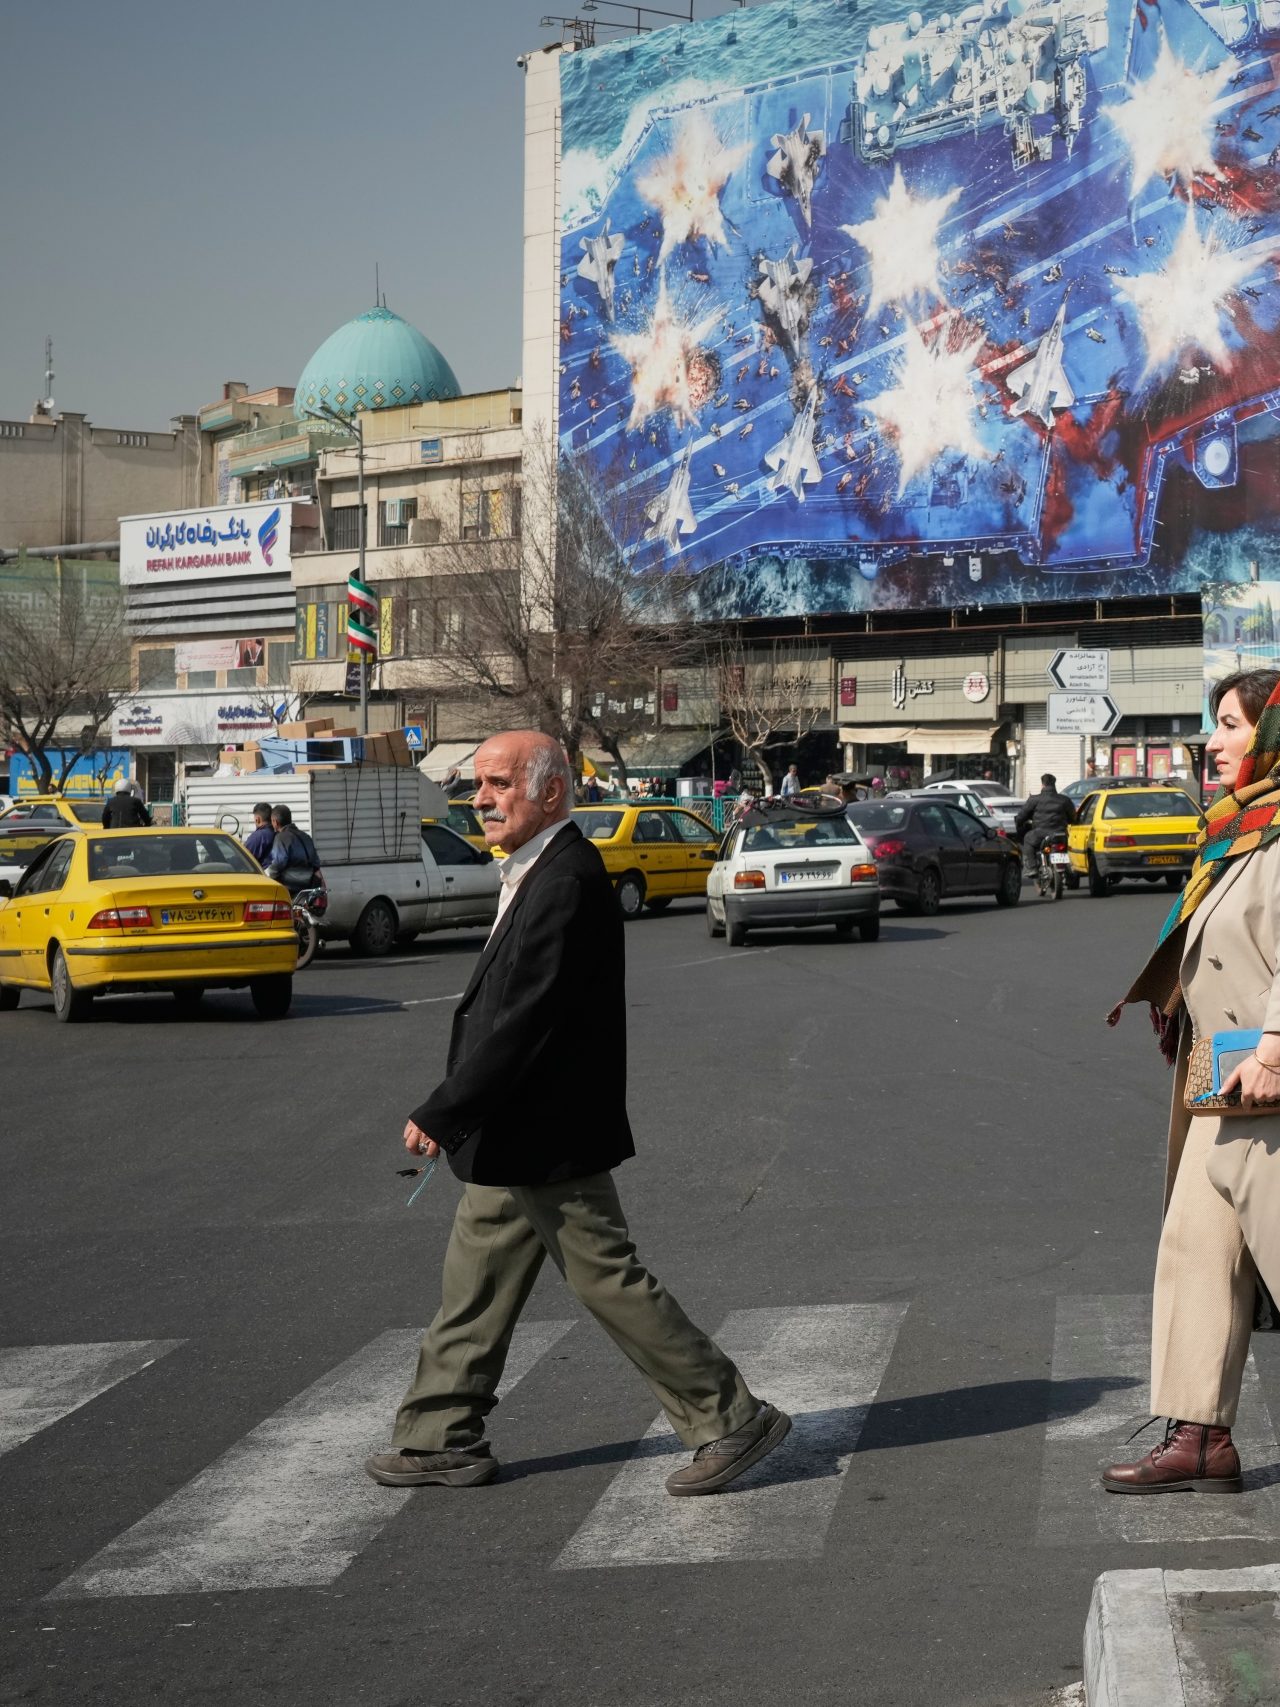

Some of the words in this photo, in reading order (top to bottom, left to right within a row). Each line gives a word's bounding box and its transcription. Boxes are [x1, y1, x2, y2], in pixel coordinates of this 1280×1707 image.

[146, 521, 187, 551] کارگران
[187, 518, 217, 547] رفاه
[146, 556, 174, 572] REFAH
[175, 552, 225, 570] KARGARAN
[226, 550, 252, 567] BANK
